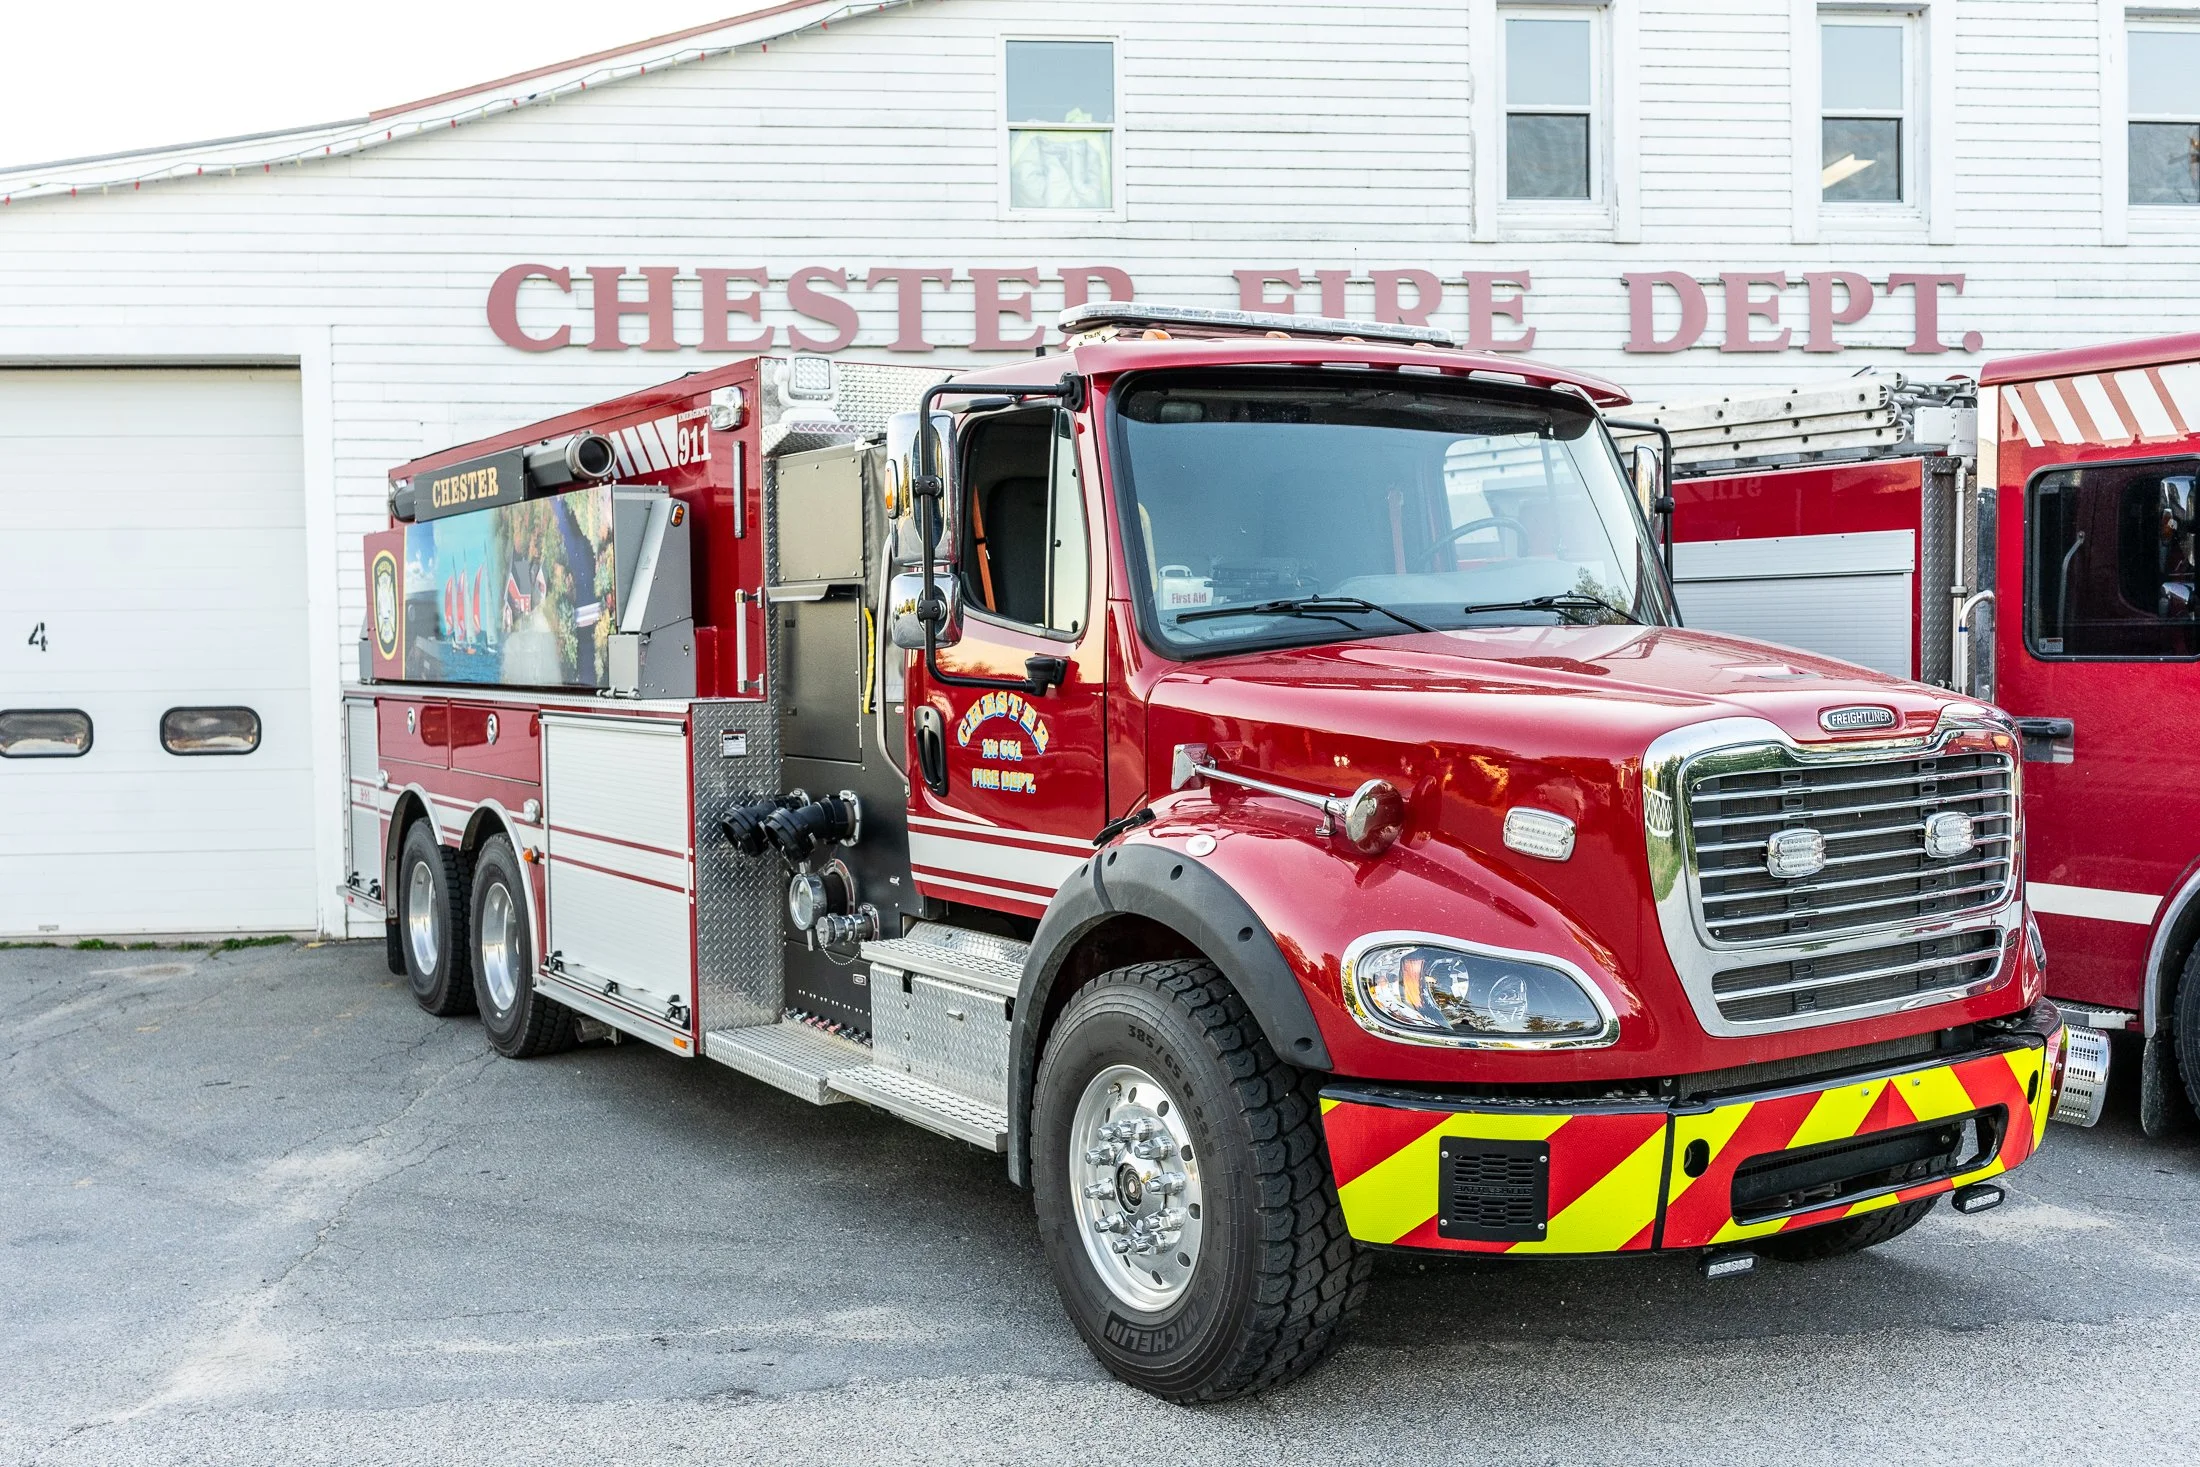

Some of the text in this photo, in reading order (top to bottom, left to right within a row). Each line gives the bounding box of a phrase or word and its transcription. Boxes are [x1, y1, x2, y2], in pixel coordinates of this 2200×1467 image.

[1232, 268, 1537, 353] FIRE
[1622, 270, 1983, 353] DEPT.
[678, 422, 712, 466] 911
[432, 467, 498, 508] CHESTER
[1171, 592, 1207, 604] First Aid
[28, 622, 48, 652] 4
[957, 691, 1049, 755] CHESTER
[1831, 711, 1890, 725] FREIGHTLINER
[971, 767, 1037, 794] FIRE DEPT.
[1182, 1081, 1194, 1101] R
[1105, 1302, 1200, 1353] MICHELIN
